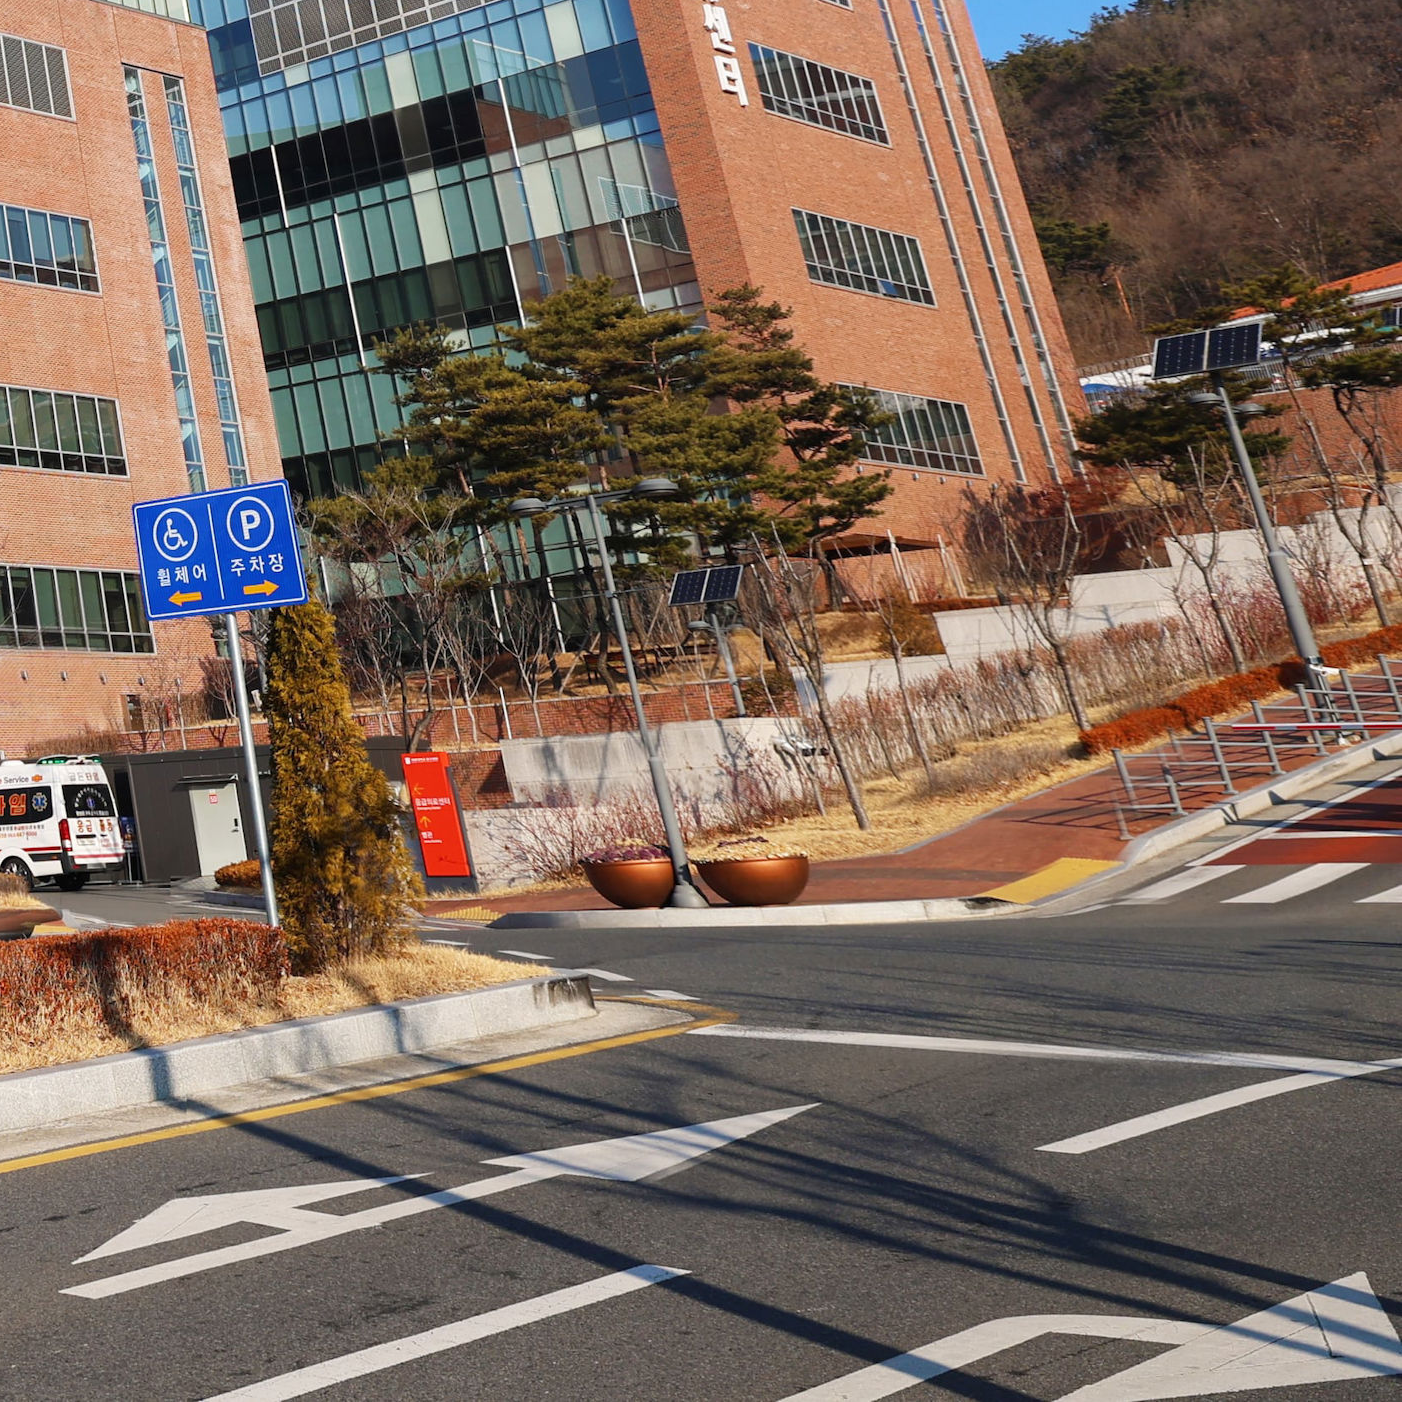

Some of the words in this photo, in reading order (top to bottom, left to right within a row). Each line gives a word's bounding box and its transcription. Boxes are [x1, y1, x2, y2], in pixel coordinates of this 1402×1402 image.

[240, 509, 261, 540] P
[156, 563, 208, 587] 휠체어
[230, 553, 284, 577] 주차장
[3, 776, 30, 784] Service
